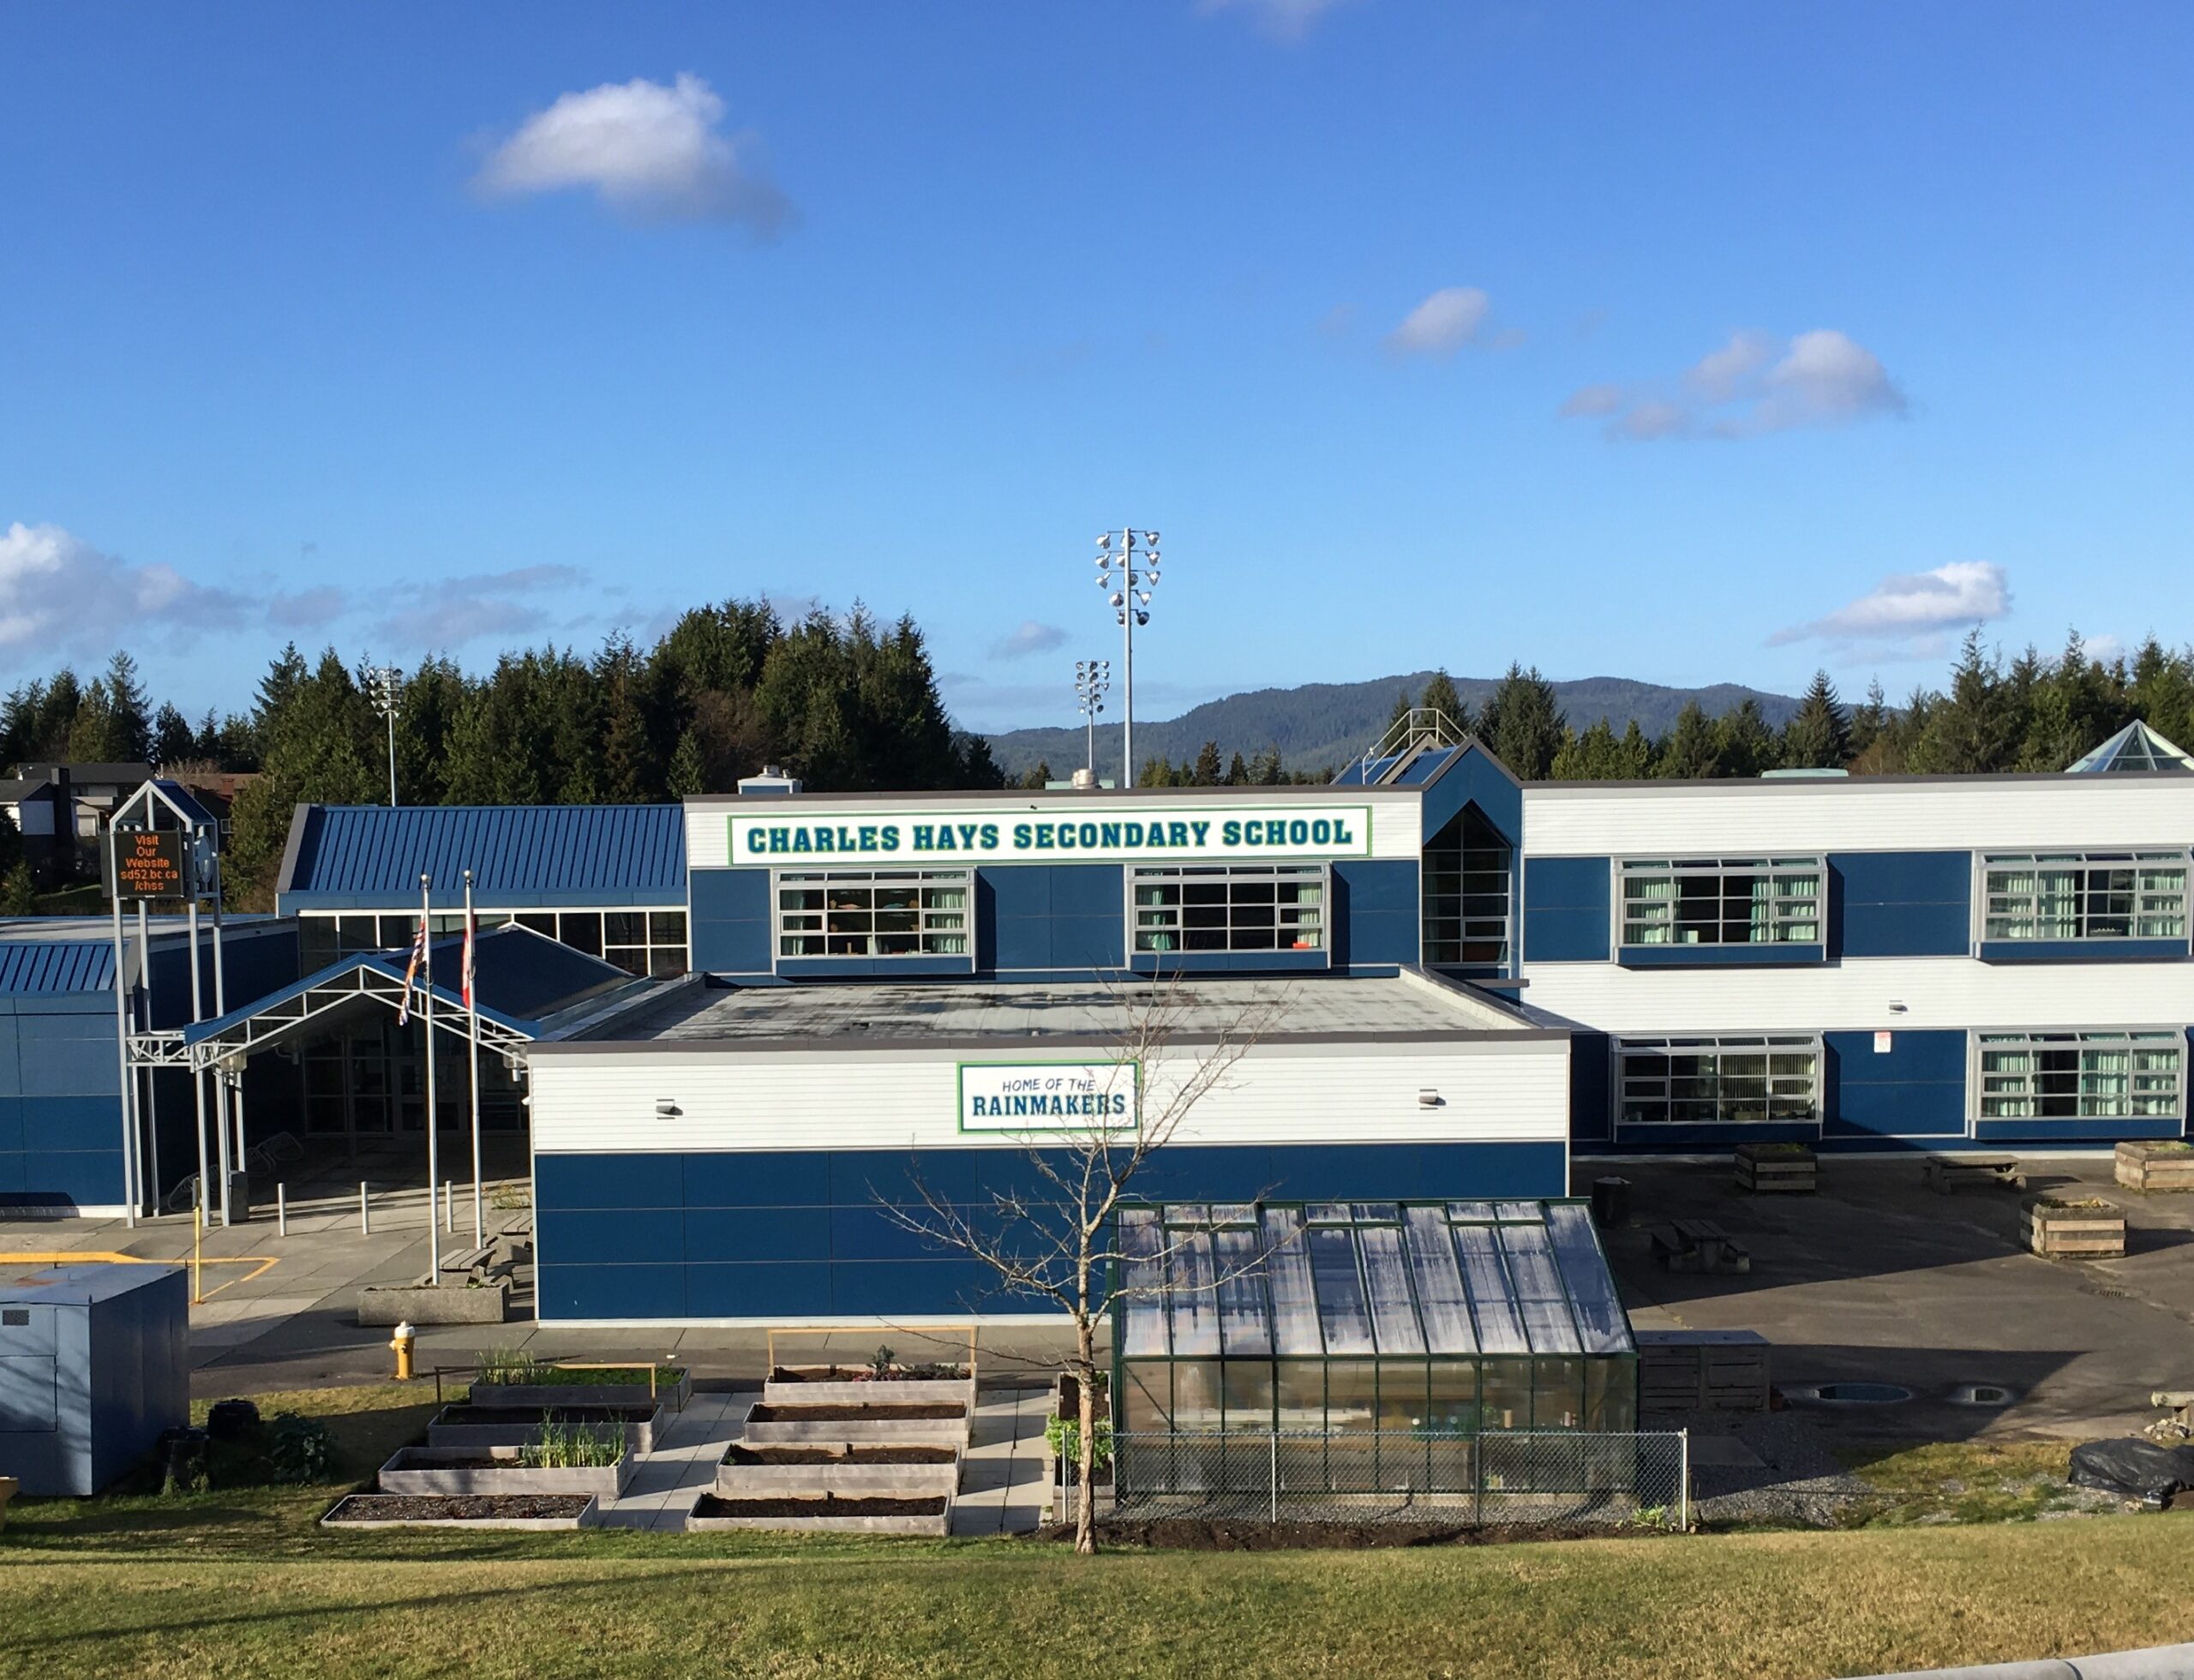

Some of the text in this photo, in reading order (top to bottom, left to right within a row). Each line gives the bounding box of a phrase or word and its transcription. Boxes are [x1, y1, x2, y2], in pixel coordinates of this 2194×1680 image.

[135, 835, 159, 846] Visit
[747, 819, 1353, 854] CHARLES HAYS SECONDARY SCHOOL
[136, 846, 156, 857] Our
[125, 858, 170, 868] Website
[1002, 1077, 1096, 1092] HOME OF THE
[972, 1094, 1126, 1116] RAINMAKERS
